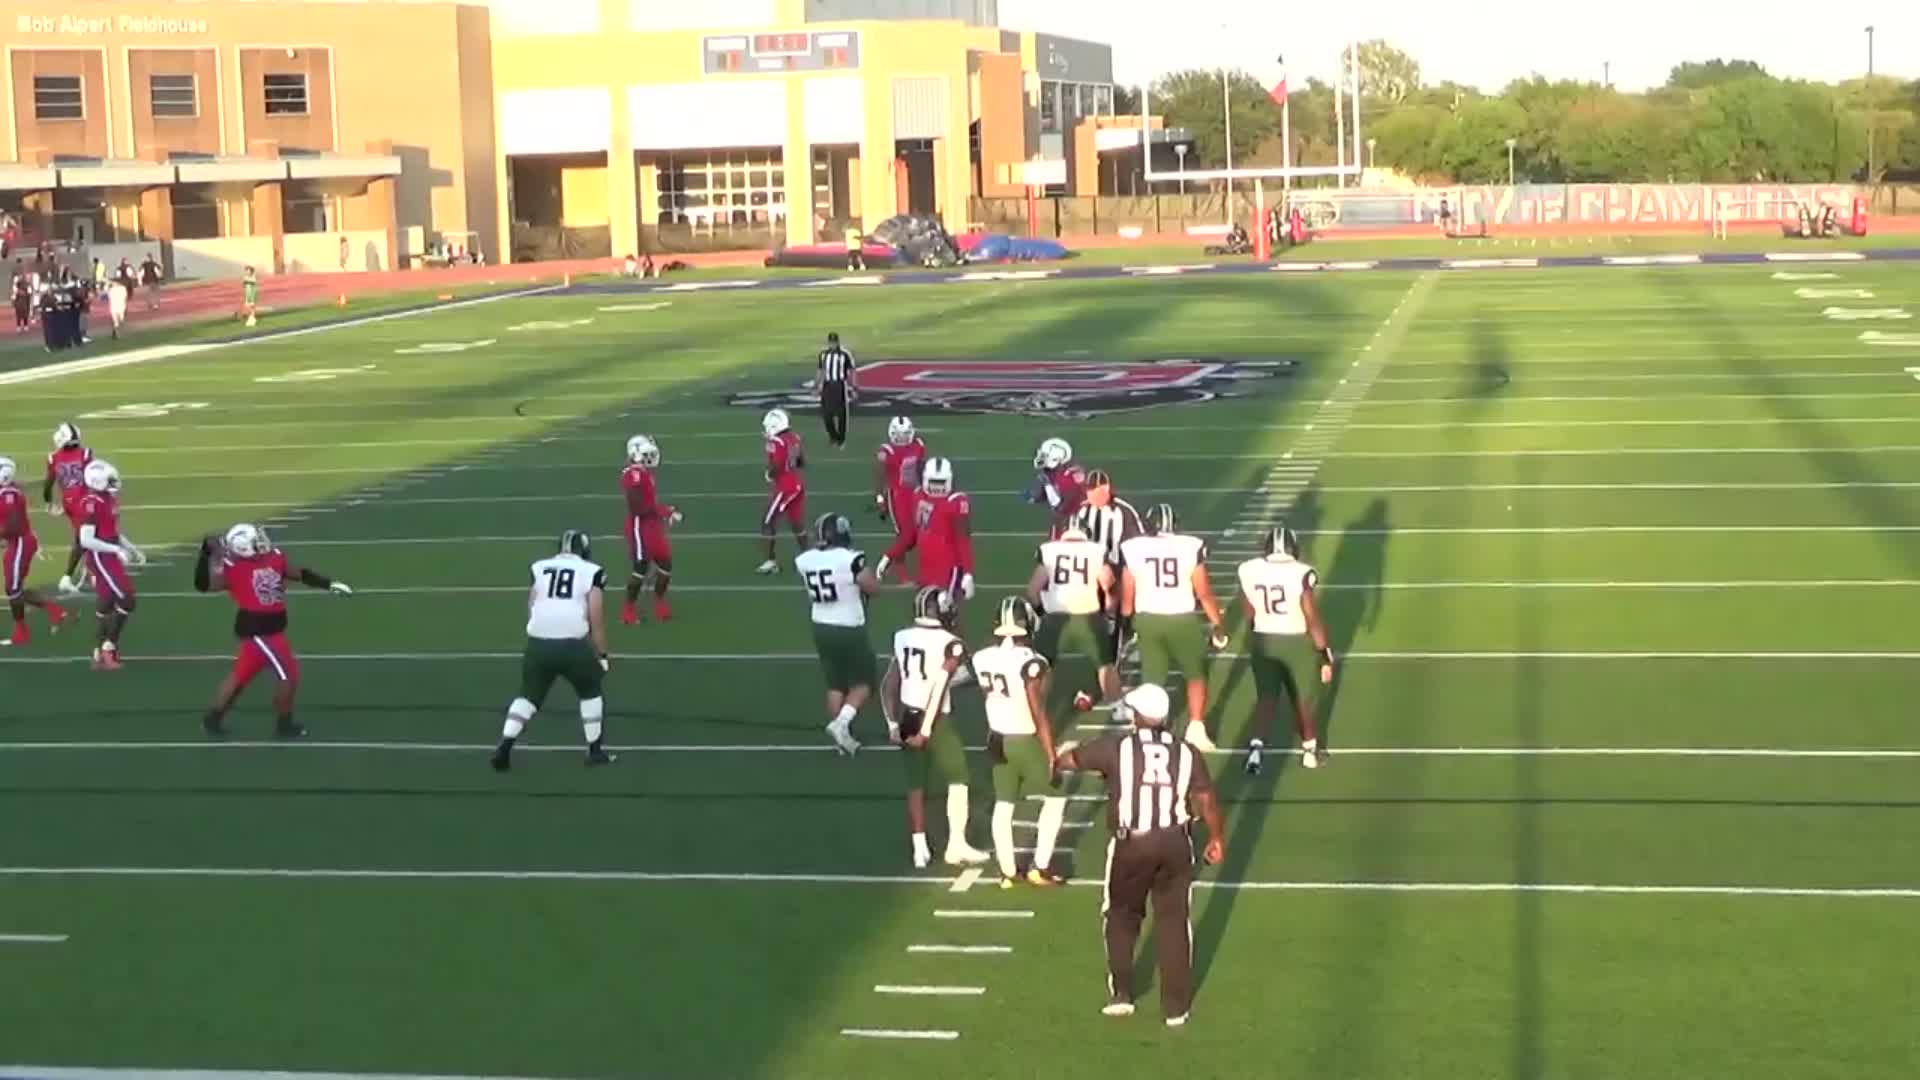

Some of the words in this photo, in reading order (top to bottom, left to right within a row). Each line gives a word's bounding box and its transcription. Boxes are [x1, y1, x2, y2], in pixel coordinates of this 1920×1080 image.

[543, 568, 576, 599] 78
[804, 568, 839, 603] 55
[1053, 555, 1089, 585] 64
[1144, 556, 1180, 588] 79
[1254, 584, 1288, 614] 72
[903, 646, 928, 681] 17
[1142, 744, 1172, 784] R
